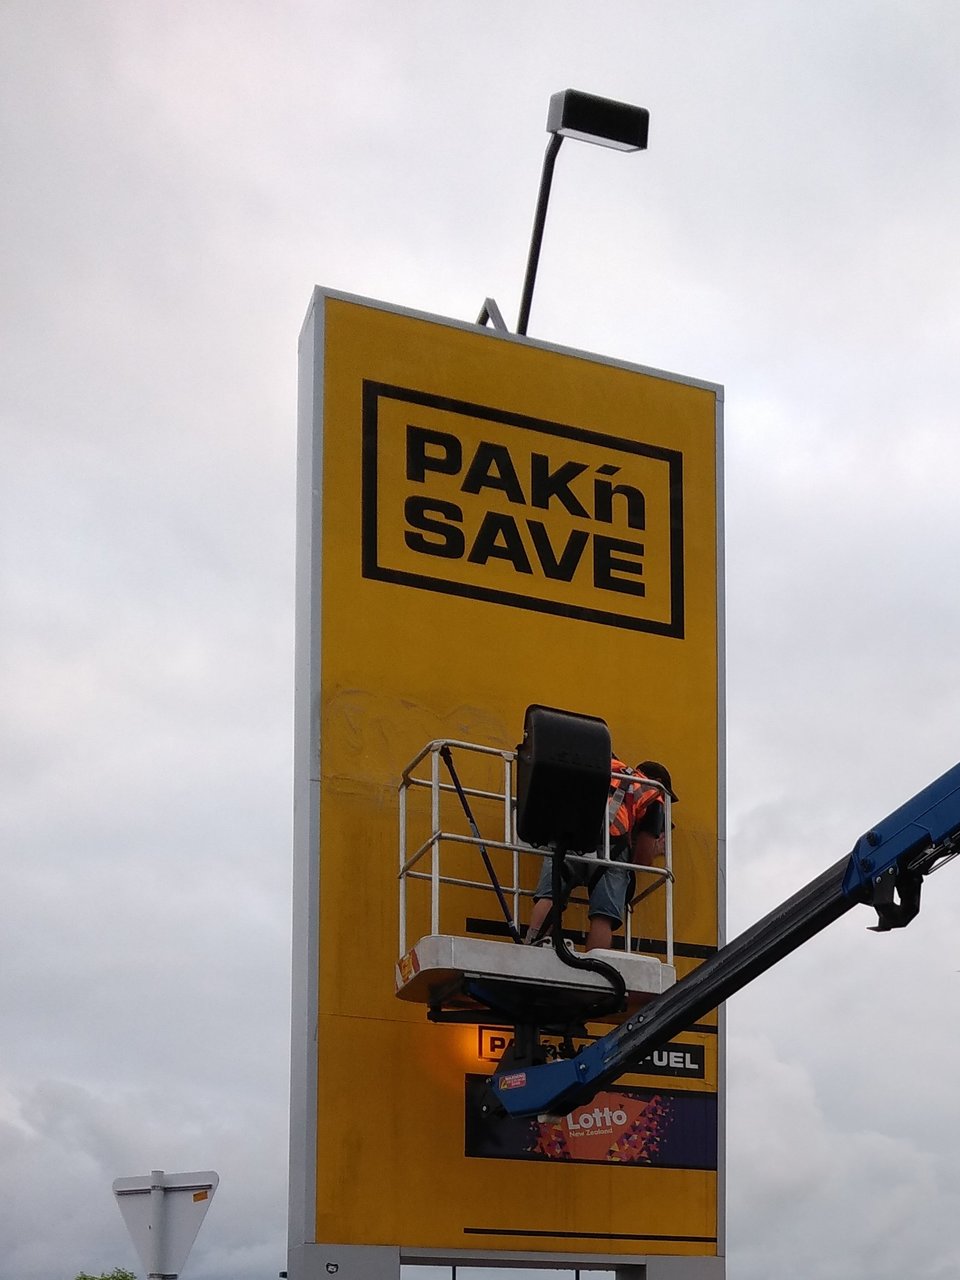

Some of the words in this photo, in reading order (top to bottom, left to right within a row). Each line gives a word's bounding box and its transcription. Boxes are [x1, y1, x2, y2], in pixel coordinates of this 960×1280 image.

[404, 495, 646, 598] SAVE
[638, 1050, 699, 1069] UEL
[566, 1107, 627, 1130] Lotto
[586, 1128, 613, 1136] Zealand
